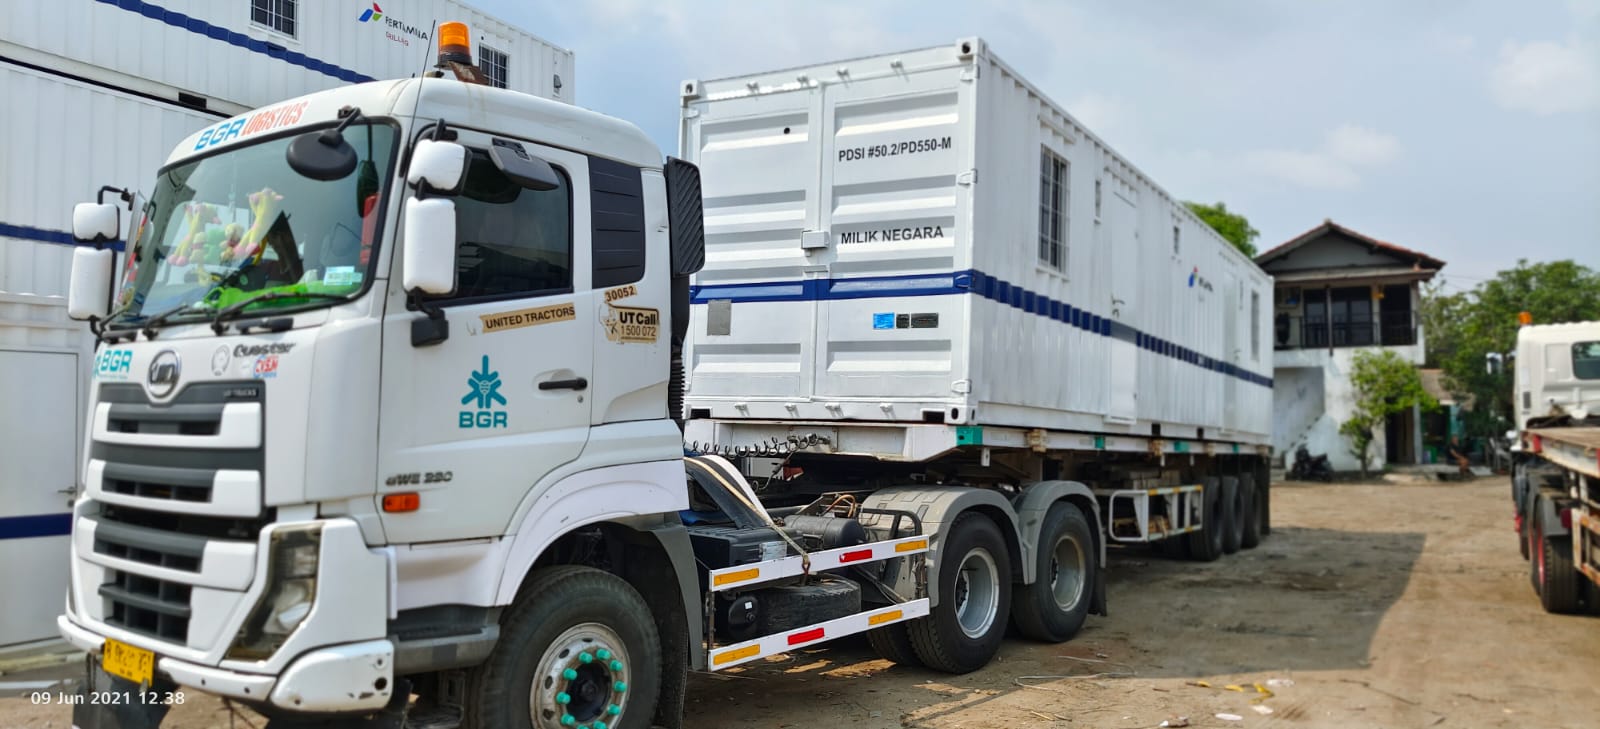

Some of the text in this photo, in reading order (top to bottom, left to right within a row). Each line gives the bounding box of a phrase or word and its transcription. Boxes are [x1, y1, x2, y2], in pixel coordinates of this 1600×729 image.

[194, 101, 309, 151] BGR LOGISTICS
[838, 136, 952, 162] PDSI #50.2/PD550-M
[841, 225, 944, 244] MILIK NEGARA
[605, 285, 636, 302] 30052
[486, 306, 575, 329] UNITED TRACTORS
[100, 349, 133, 373] BGR
[458, 411, 508, 428] BGR
